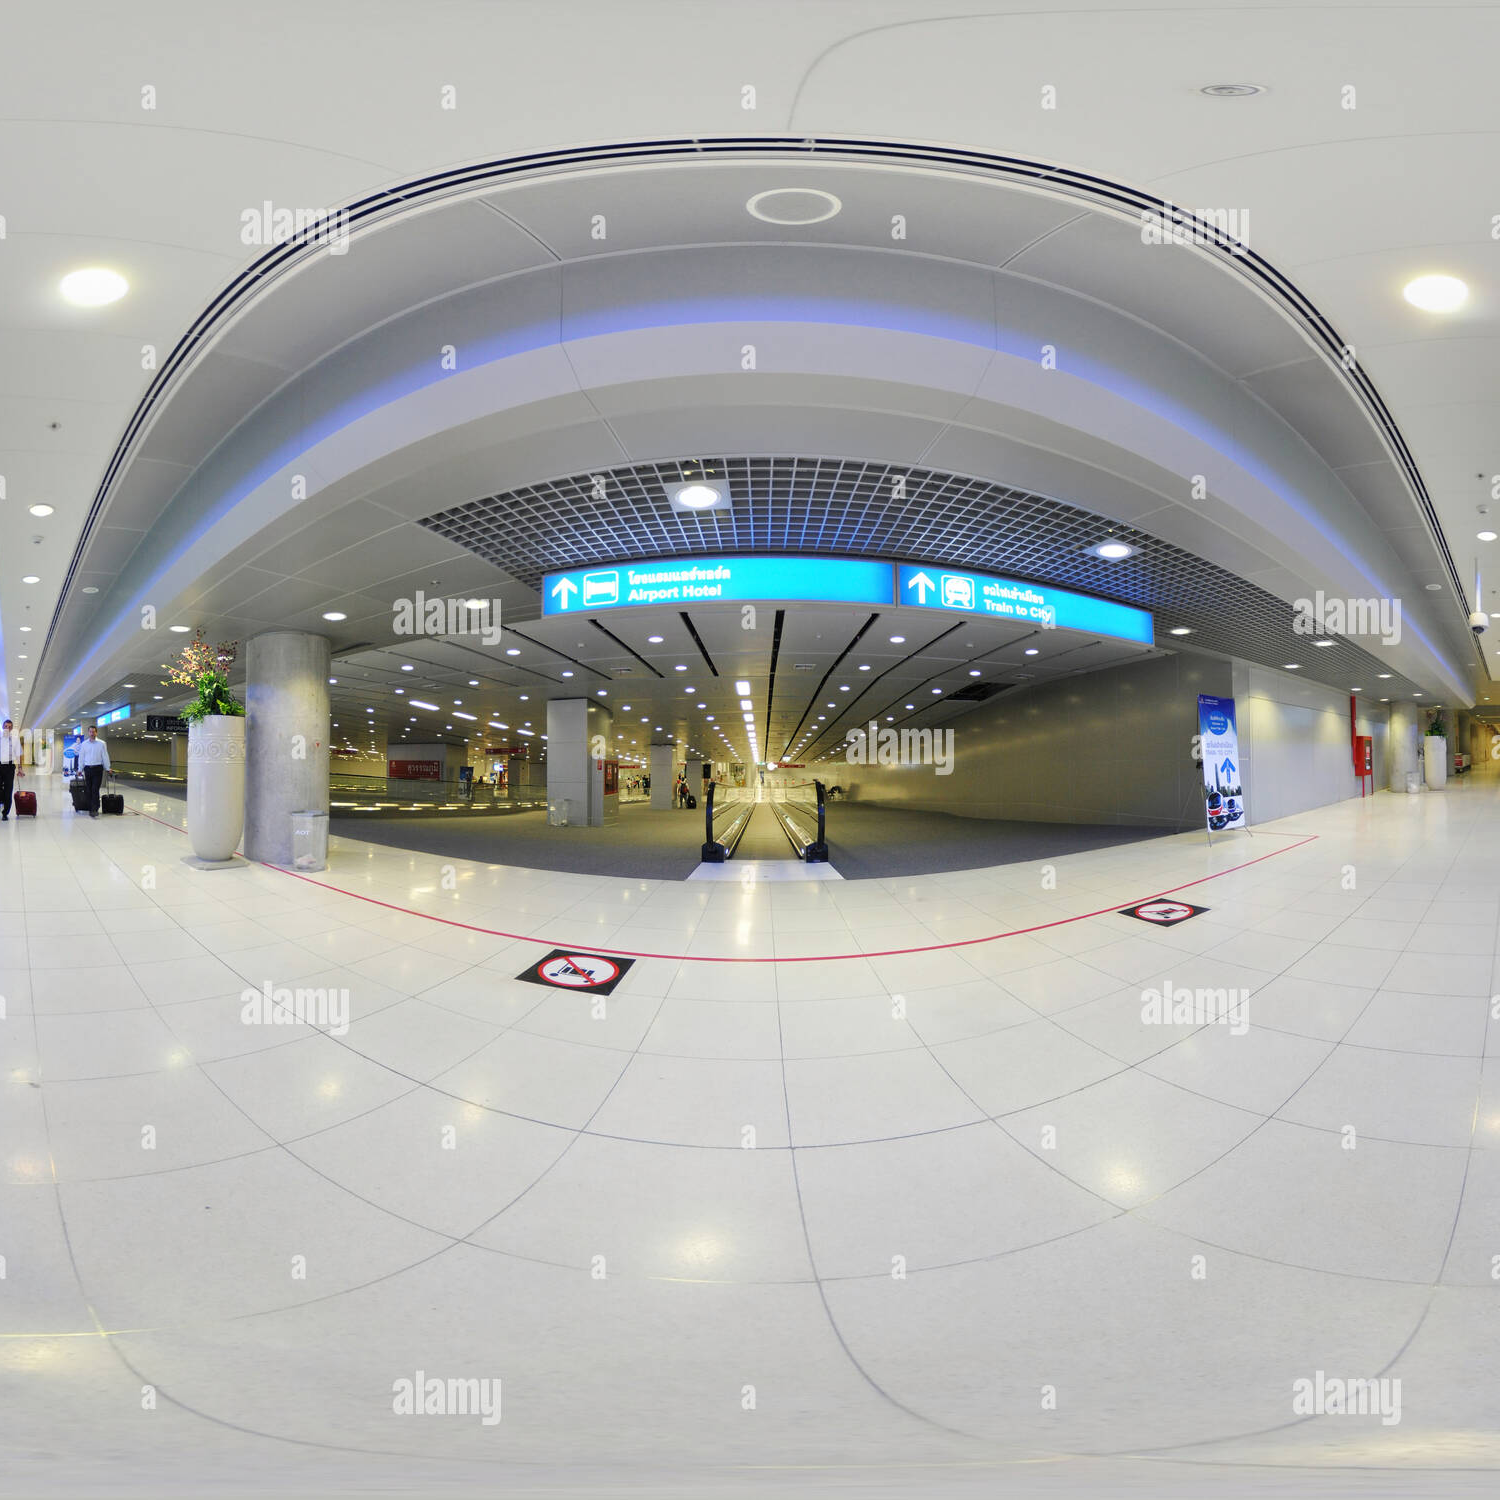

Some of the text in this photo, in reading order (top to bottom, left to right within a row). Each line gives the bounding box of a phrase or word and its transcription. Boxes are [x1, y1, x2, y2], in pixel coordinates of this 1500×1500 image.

[628, 584, 722, 602] Airport Hotel
[984, 599, 1052, 622] Train to City
